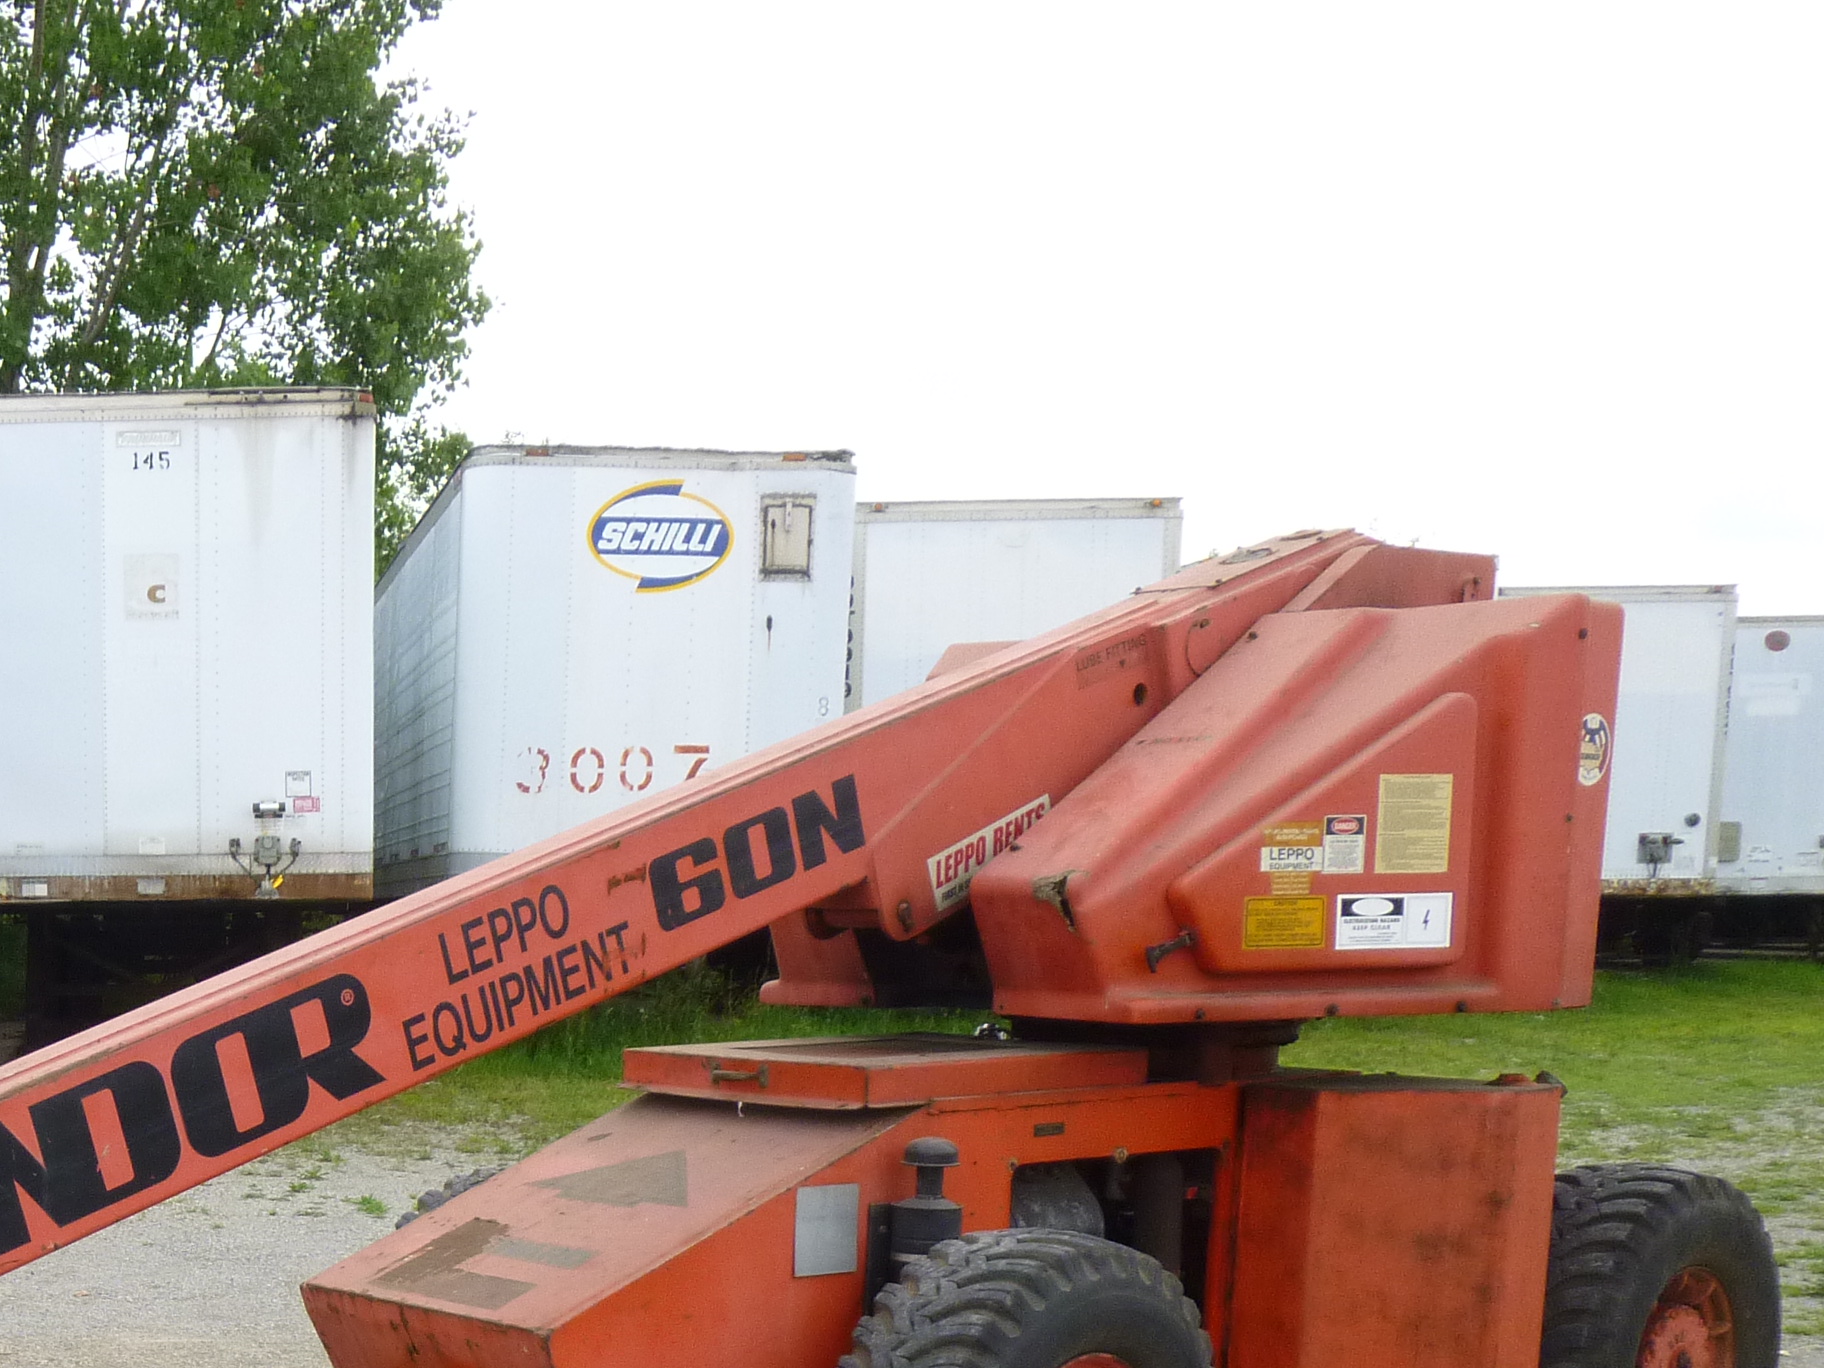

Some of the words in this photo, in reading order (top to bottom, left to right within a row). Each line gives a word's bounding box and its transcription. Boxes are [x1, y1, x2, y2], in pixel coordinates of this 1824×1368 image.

[132, 450, 171, 470] 145
[597, 521, 723, 552] SCHILLI
[515, 744, 710, 794] 3007
[647, 773, 866, 933] 60N
[936, 834, 987, 890] LEPPO
[992, 801, 1046, 858] RENTS
[1268, 860, 1315, 871] EQUIPMENT
[1269, 847, 1316, 861] LEPPO
[436, 884, 570, 986] LEPPO
[401, 920, 632, 1073] EQUIPMENT
